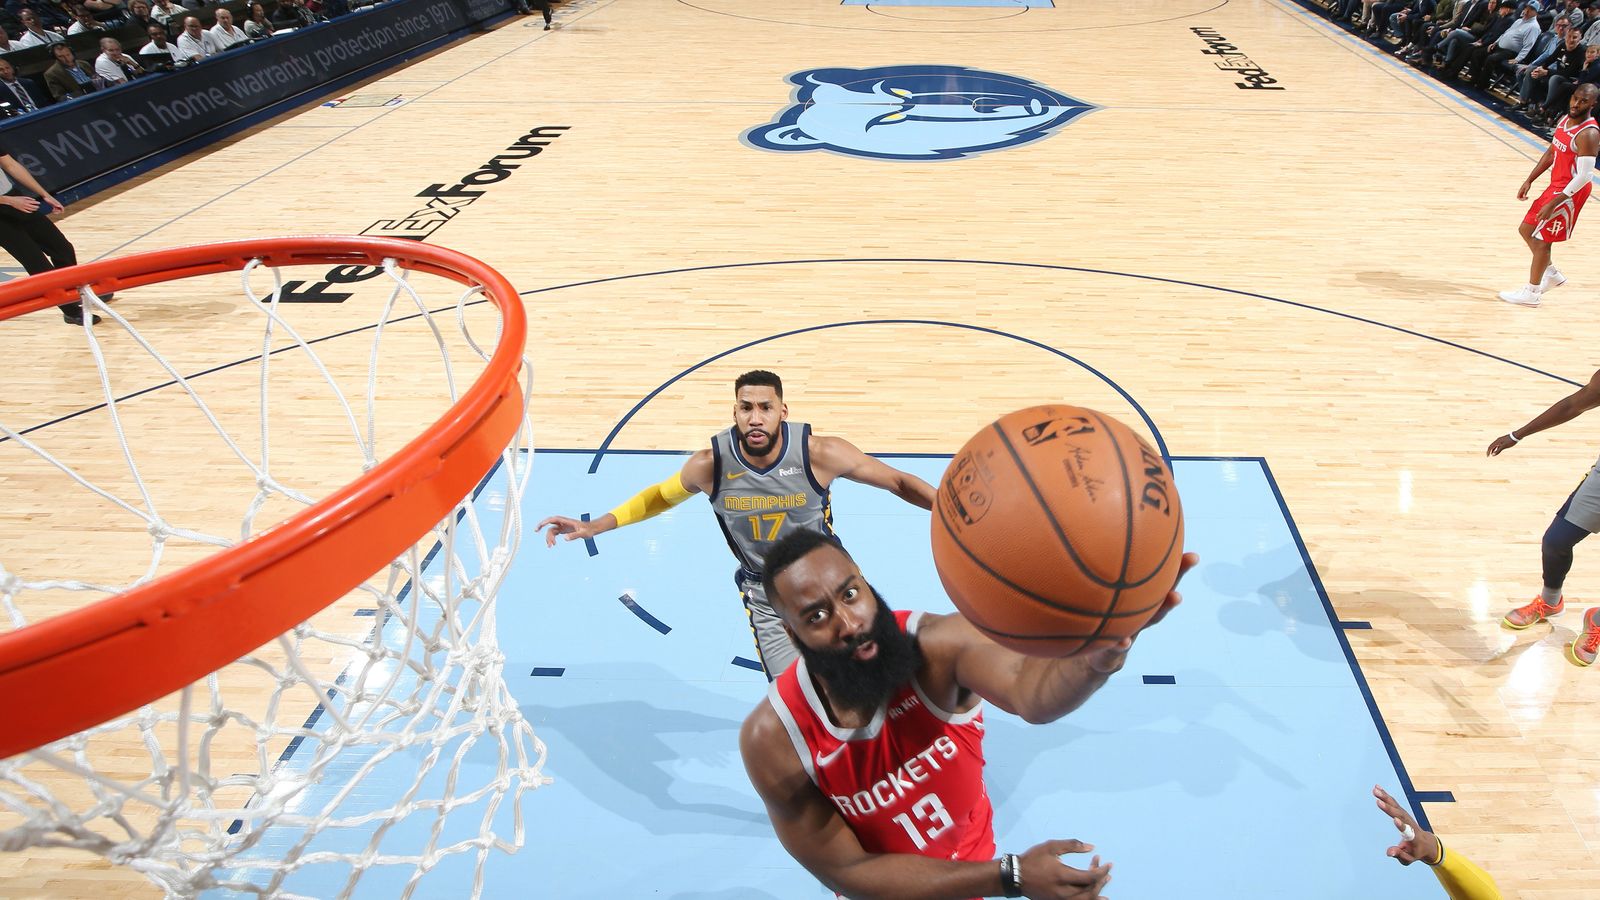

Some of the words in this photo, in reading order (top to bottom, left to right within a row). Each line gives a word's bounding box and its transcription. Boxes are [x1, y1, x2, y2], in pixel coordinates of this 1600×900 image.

[38, 119, 117, 168] MVP
[116, 112, 156, 139] in
[148, 86, 227, 127] home
[226, 56, 316, 100] warranty
[315, 28, 394, 69] protection
[394, 14, 428, 38] since
[426, 2, 457, 26] 1971
[262, 126, 572, 303] FeExForum
[778, 466, 803, 477] FedEx
[724, 493, 807, 511] MEMPHIS
[748, 511, 788, 541] 17
[830, 735, 959, 817] ROCKETS
[891, 793, 954, 851] 13
